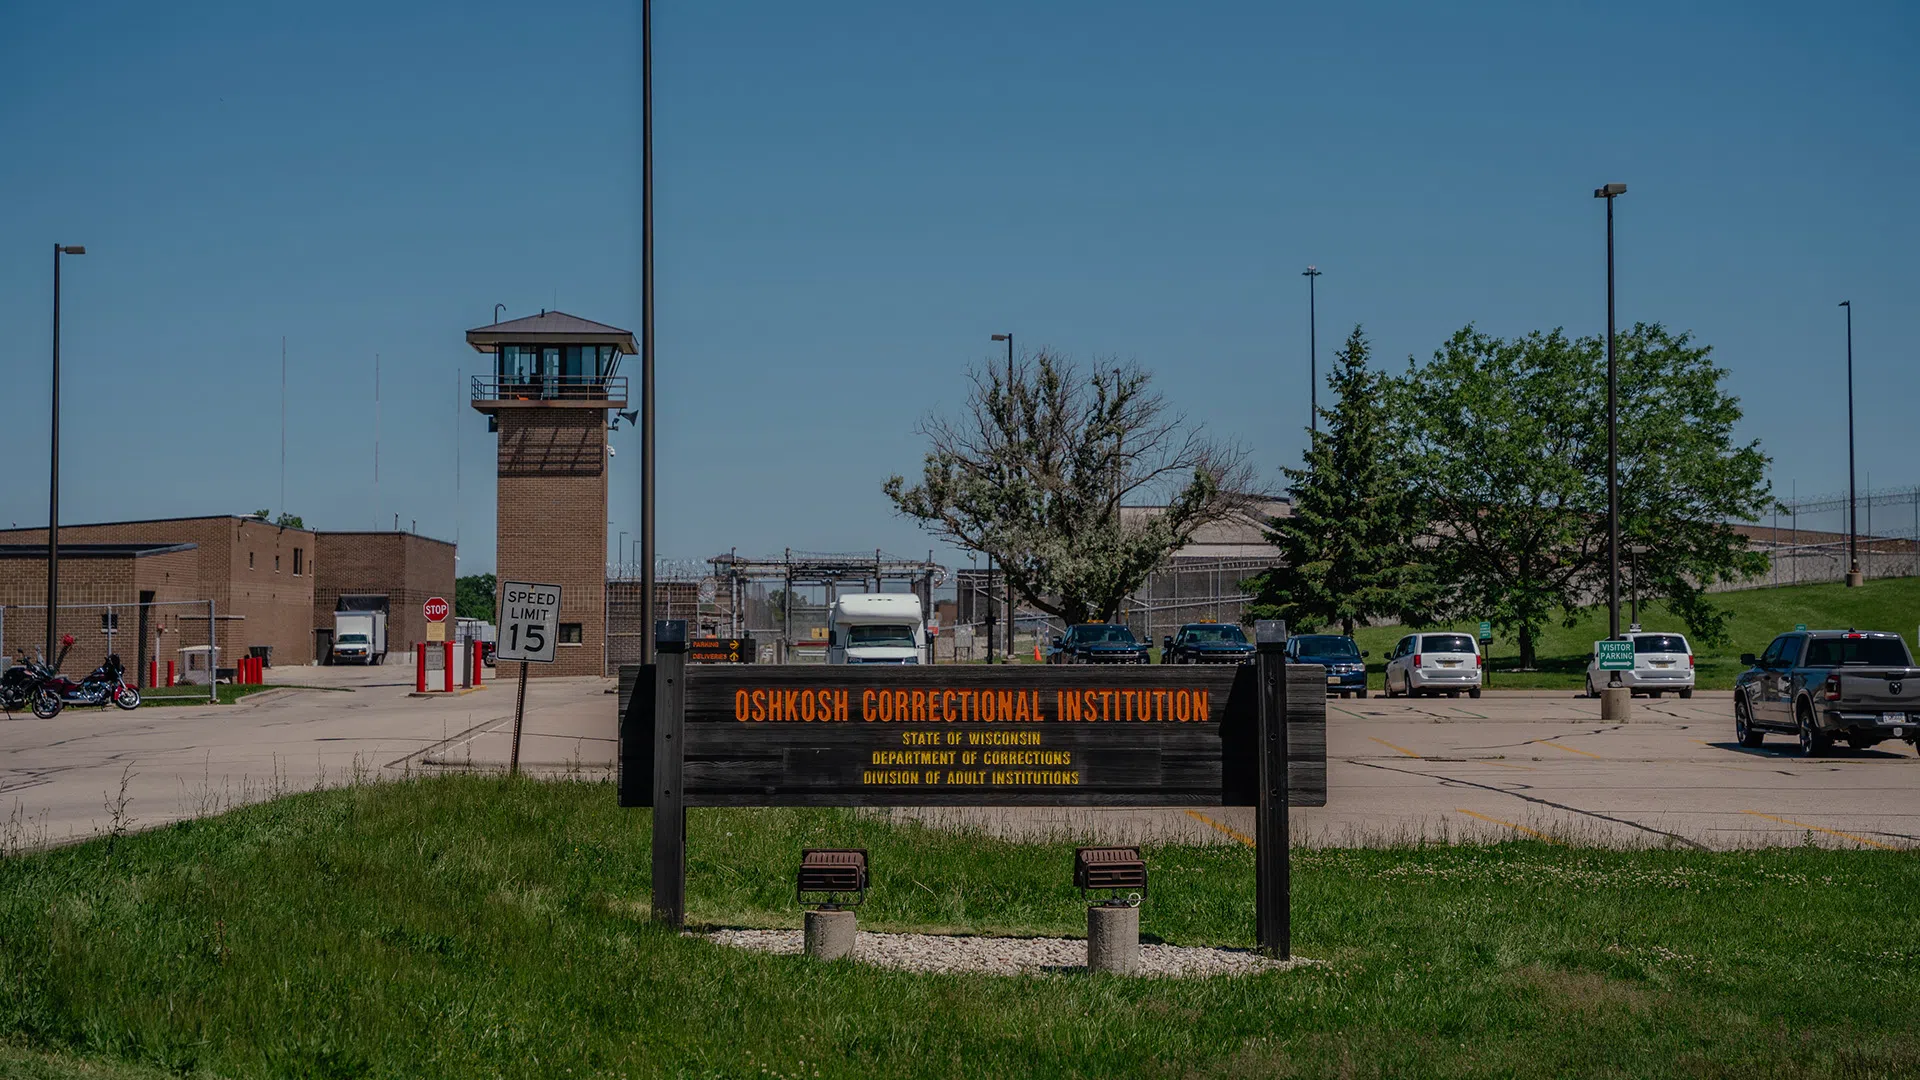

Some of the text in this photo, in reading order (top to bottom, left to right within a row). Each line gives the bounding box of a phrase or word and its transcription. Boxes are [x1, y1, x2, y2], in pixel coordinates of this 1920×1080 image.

[508, 591, 556, 606] SPEED
[425, 604, 447, 615] STOP
[511, 607, 549, 621] LIMIT
[510, 623, 545, 653] 15
[1602, 643, 1631, 651] VISITOR
[1600, 652, 1633, 660] PARKING
[735, 688, 1209, 722] OSHKOSH CORRECTIONAL INSTITUTION
[902, 731, 1041, 745] STATE OF WISCONSIN
[872, 750, 1072, 765] DEPARTMENT OF CORRECTIONS
[863, 770, 1080, 785] DIVISION OF ADULT INSTITUTIONS
